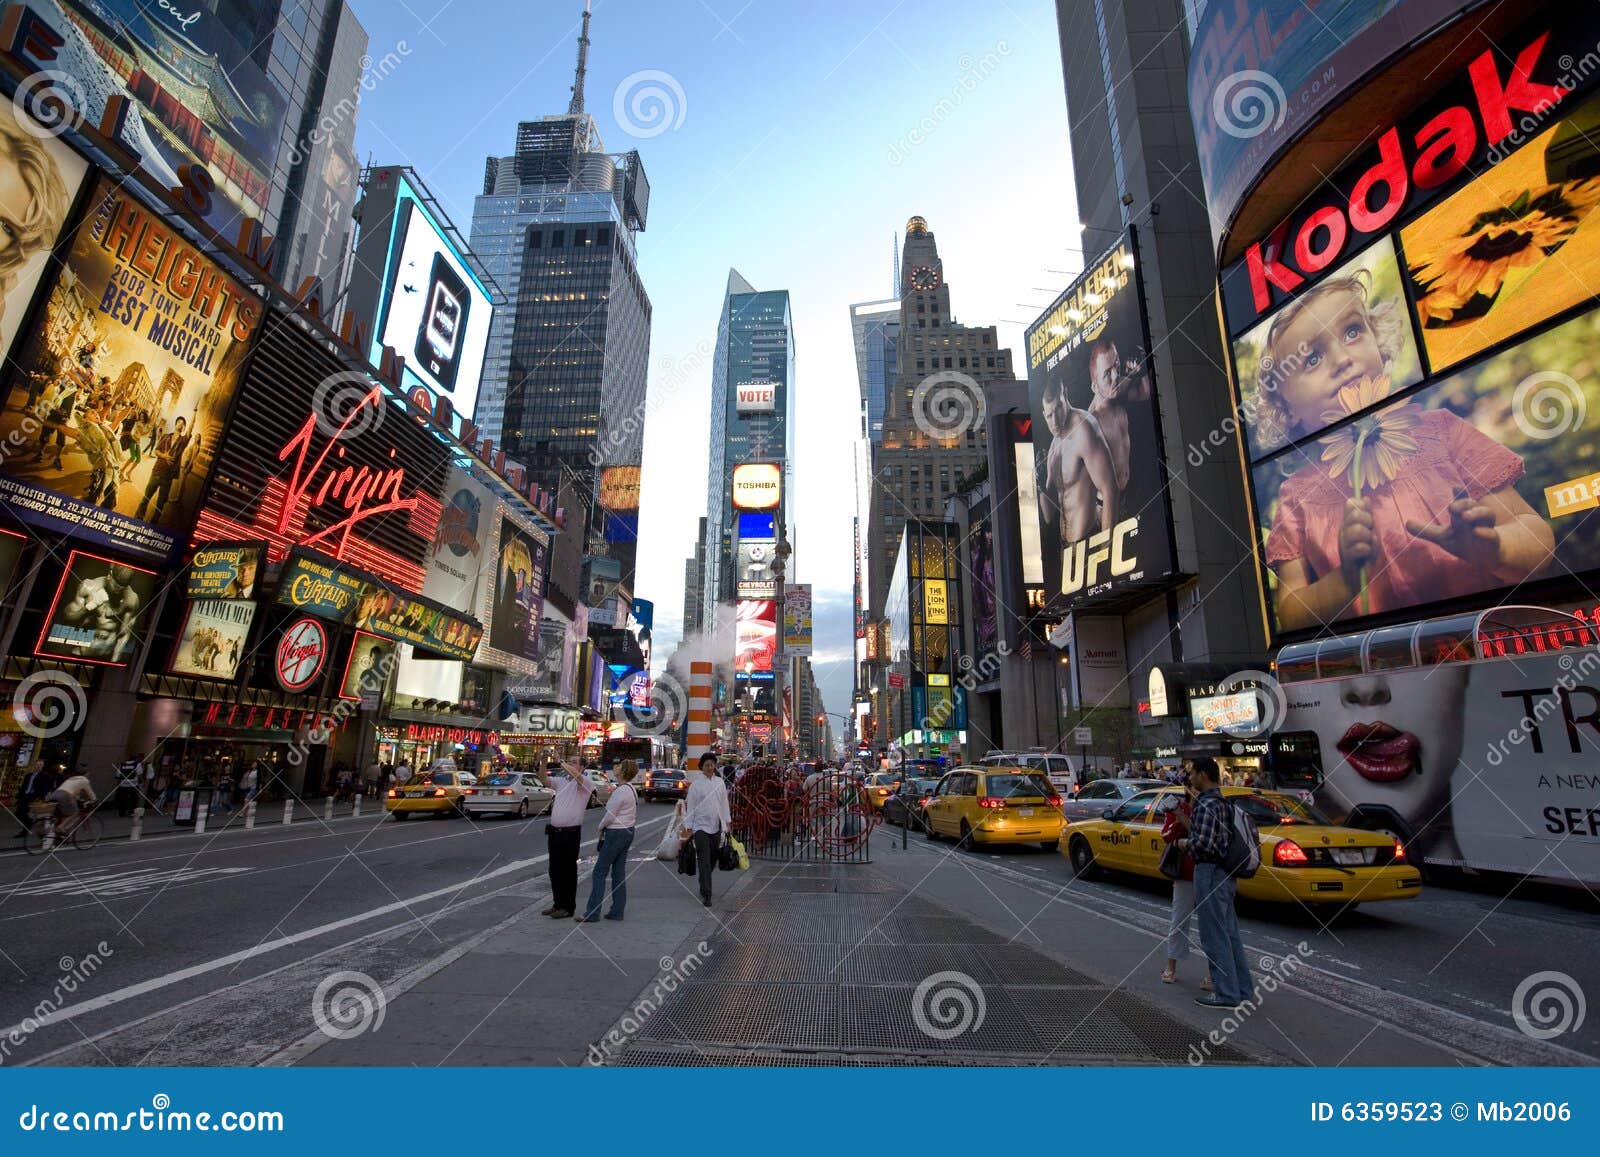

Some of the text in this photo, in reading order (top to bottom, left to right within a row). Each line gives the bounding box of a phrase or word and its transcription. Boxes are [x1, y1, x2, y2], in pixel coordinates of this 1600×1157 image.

[101, 200, 259, 343] HEIGHTS
[110, 263, 221, 347] 2008 TONY AWARD
[99, 280, 217, 376] BEST MUSICAL
[1081, 310, 1110, 340] SPIKE
[739, 390, 773, 403] VOTE!
[278, 383, 418, 562] Virgin
[737, 482, 777, 490] TOSHIBA
[10, 495, 47, 513] RICHARD
[46, 506, 82, 524] RODGERS
[81, 517, 113, 535] THEATRE,
[149, 538, 173, 551] STREET
[1061, 517, 1139, 595] UFC
[291, 573, 351, 610] CURTAINS
[738, 581, 775, 589] CHEVROLET
[280, 621, 323, 683] Virgin
[1189, 679, 1257, 697] MARQUIS
[407, 724, 446, 742] PLANET
[447, 727, 500, 746] HOLLYWOD
[1537, 773, 1551, 788] A
